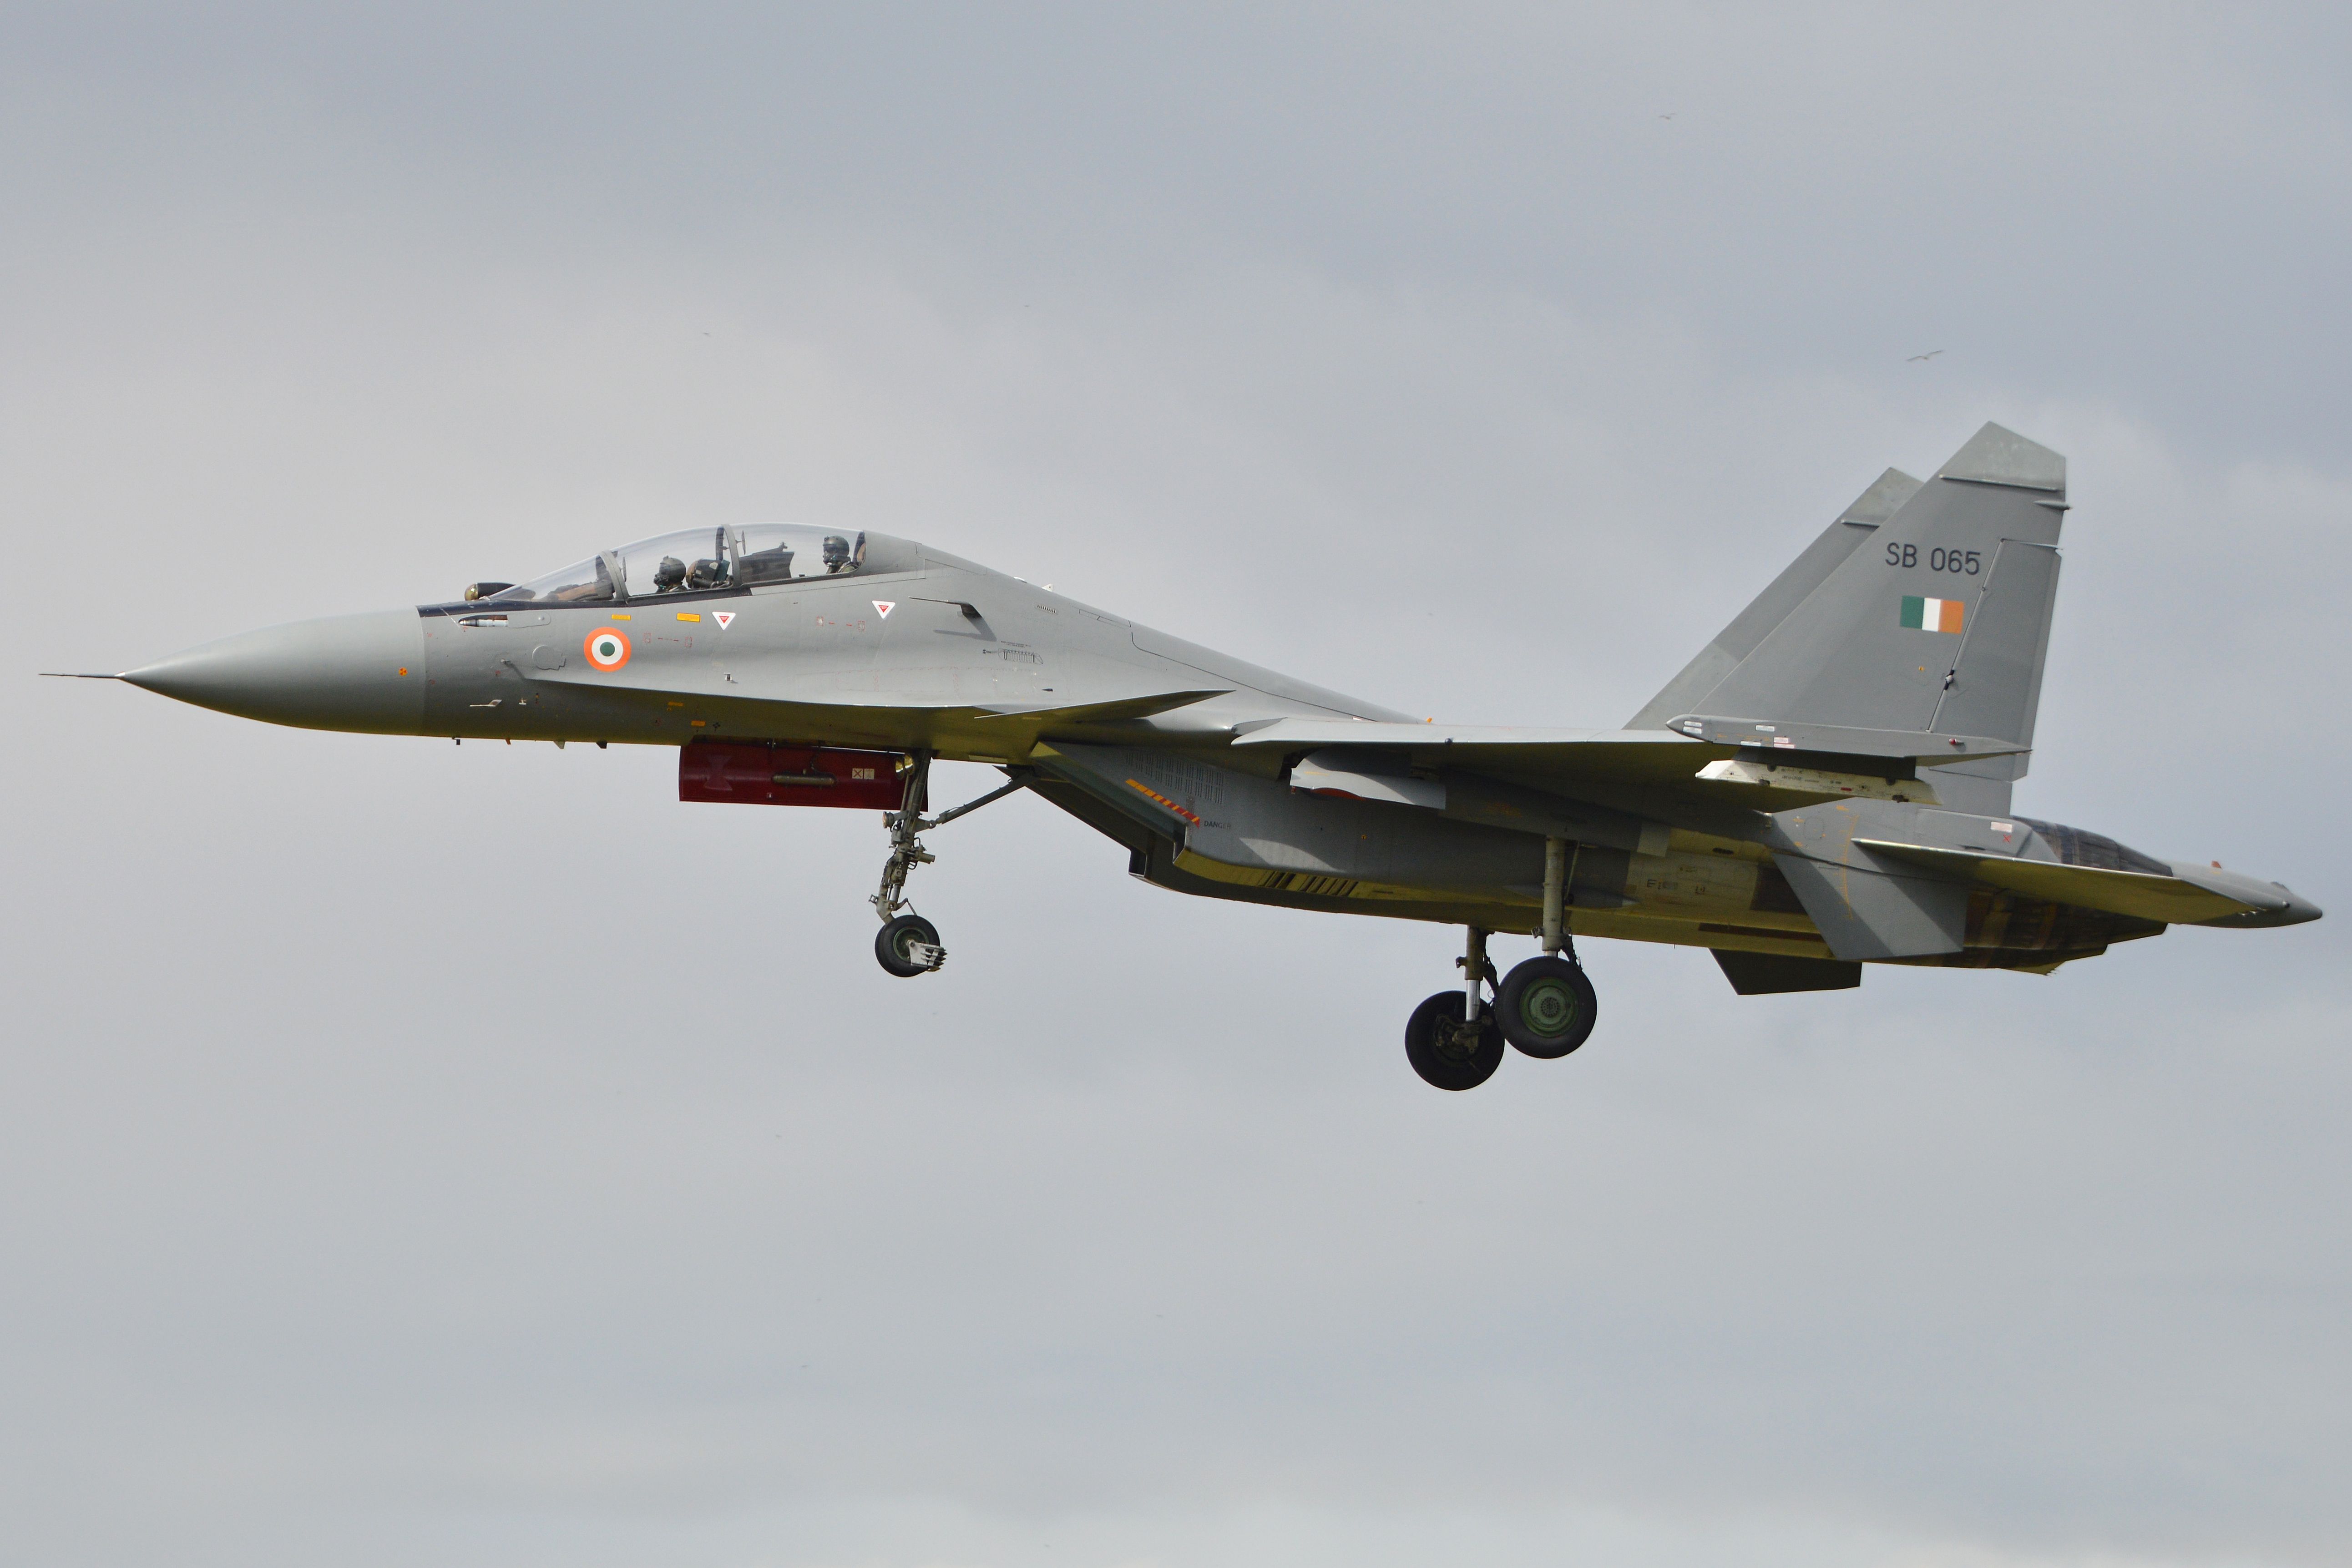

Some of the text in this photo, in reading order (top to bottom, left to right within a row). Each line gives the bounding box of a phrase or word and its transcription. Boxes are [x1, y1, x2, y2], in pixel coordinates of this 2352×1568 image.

[1885, 542, 1980, 575] SB 065
[1204, 820, 1231, 829] DANGER
